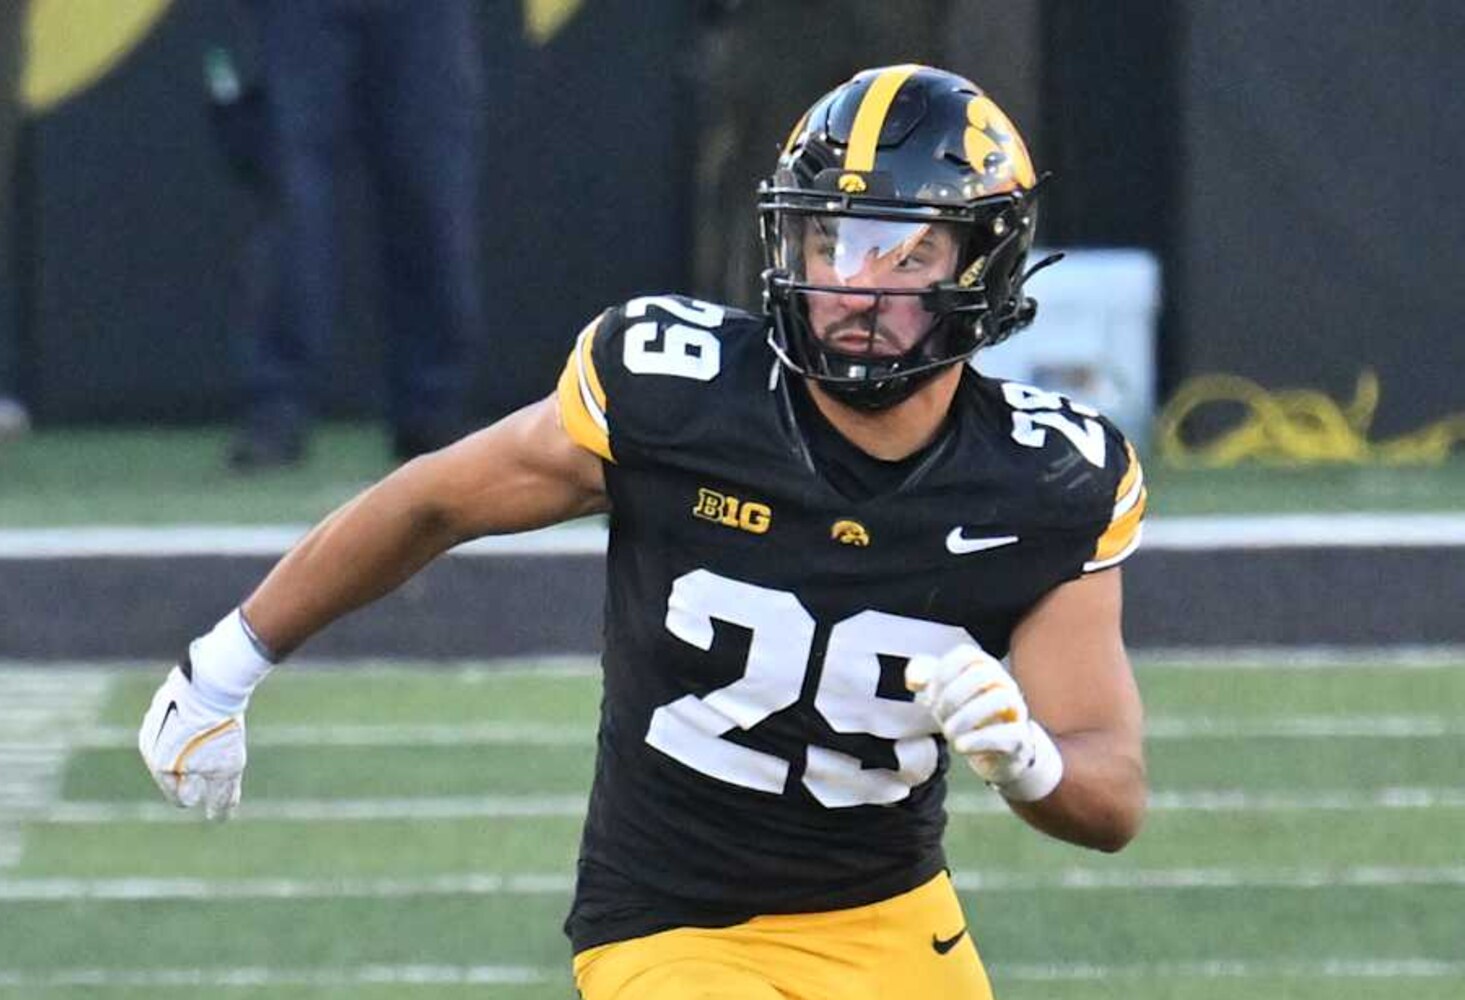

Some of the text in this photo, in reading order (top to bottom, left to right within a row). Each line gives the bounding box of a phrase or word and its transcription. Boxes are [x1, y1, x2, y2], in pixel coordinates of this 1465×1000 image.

[623, 294, 725, 381] 29
[1001, 382, 1106, 469] 29
[645, 568, 981, 809] 29
